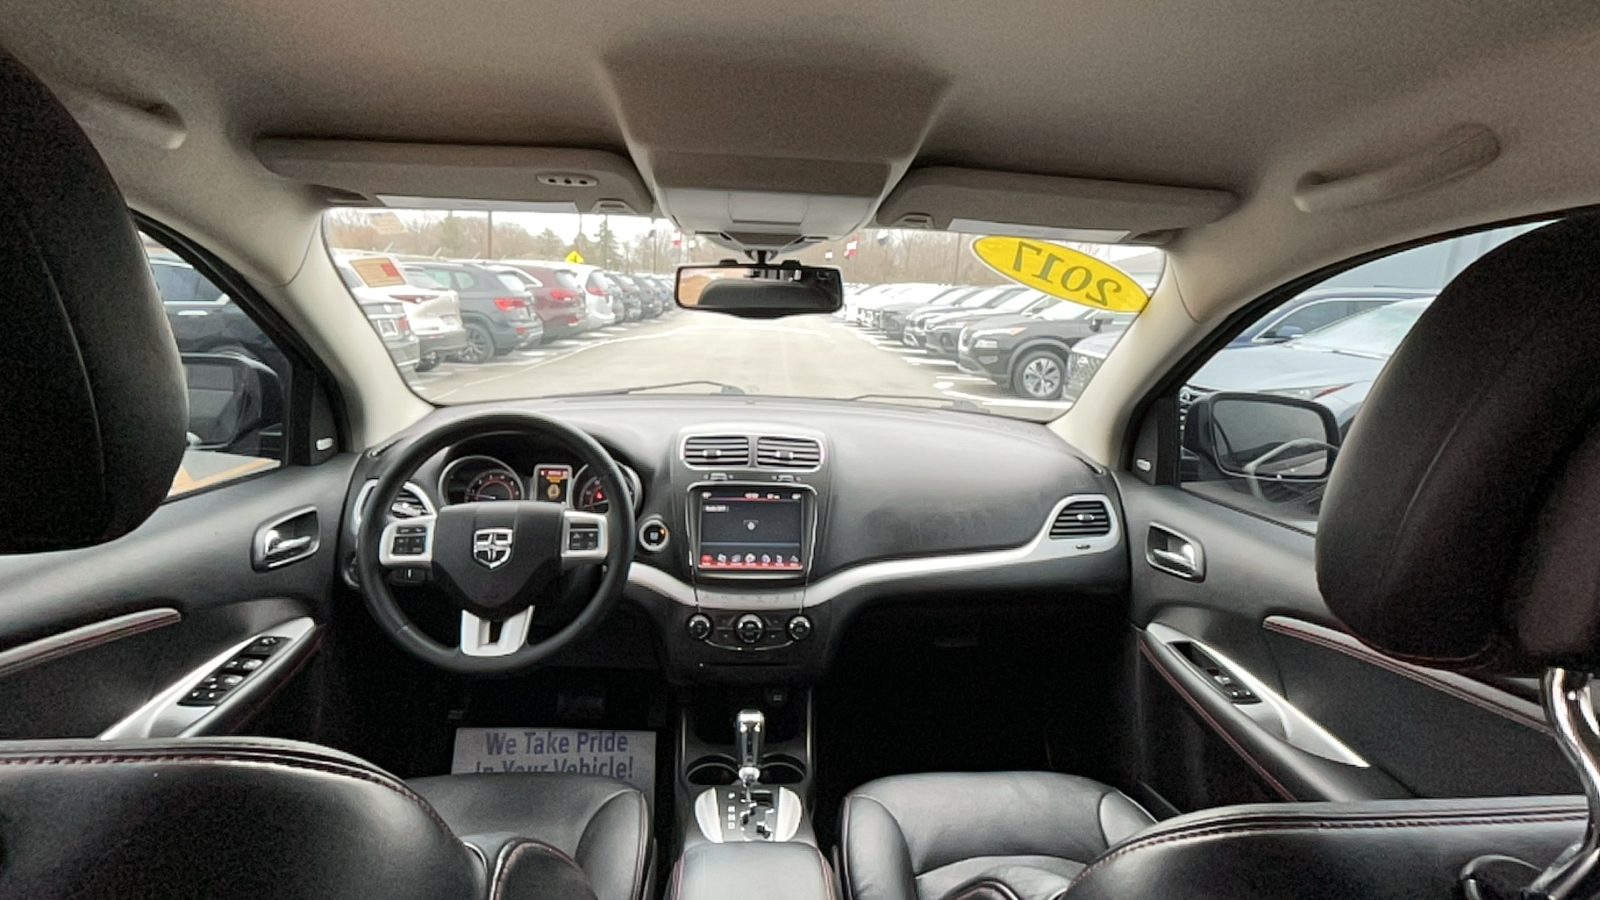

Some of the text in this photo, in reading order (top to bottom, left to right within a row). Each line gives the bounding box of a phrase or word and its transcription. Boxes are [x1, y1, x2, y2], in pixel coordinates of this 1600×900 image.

[486, 731, 628, 755] We Take Pride
